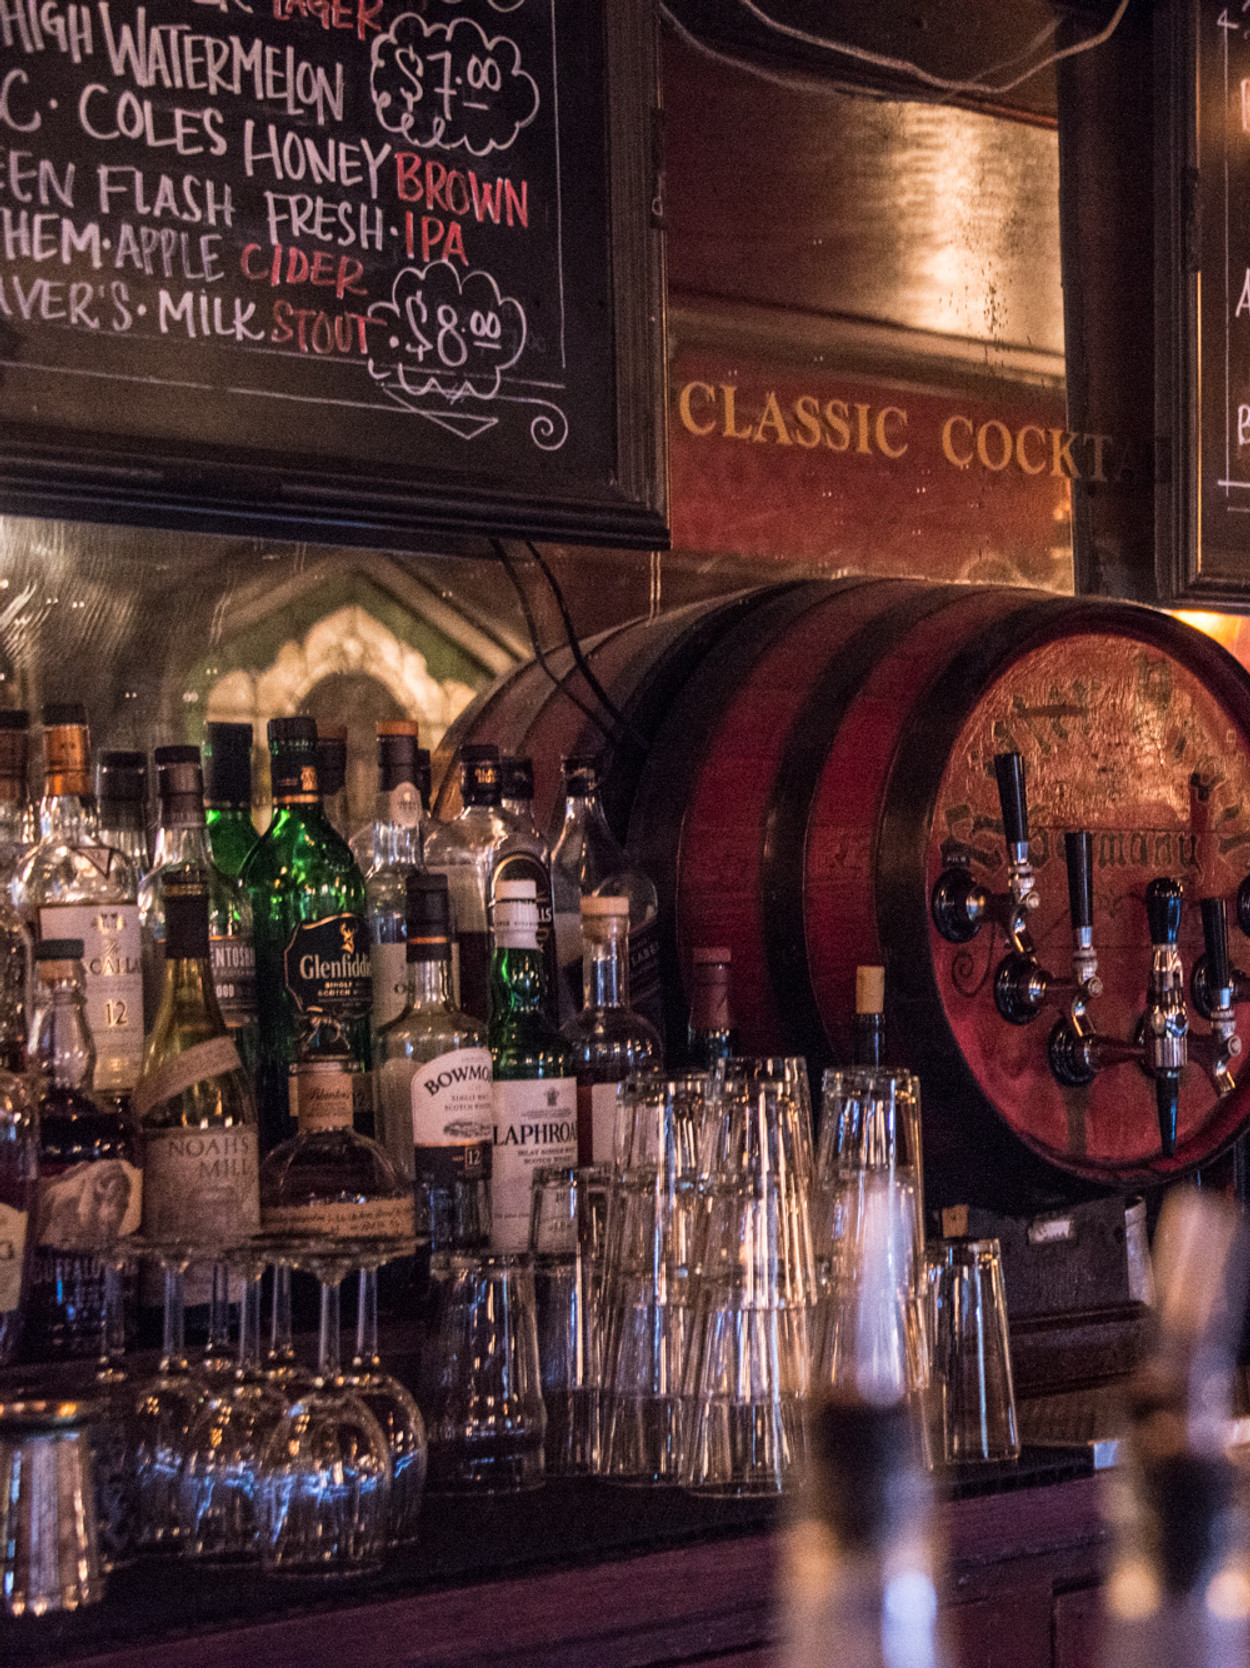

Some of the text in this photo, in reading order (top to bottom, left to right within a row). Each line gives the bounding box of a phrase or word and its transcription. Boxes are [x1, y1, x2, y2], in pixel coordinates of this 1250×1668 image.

[98, 1, 344, 125] WATERMELON
[79, 84, 228, 156] COLES
[245, 119, 392, 199] HONEY
[395, 152, 528, 228] BROWN
[0, 150, 469, 266] EN FLASH FRESH IPA
[114, 223, 225, 283] APPLE
[240, 243, 368, 299] CIDER
[158, 288, 265, 342] MILK
[271, 300, 388, 355] STOUT
[679, 381, 908, 458] CLASSIC
[106, 1001, 128, 1026] 12
